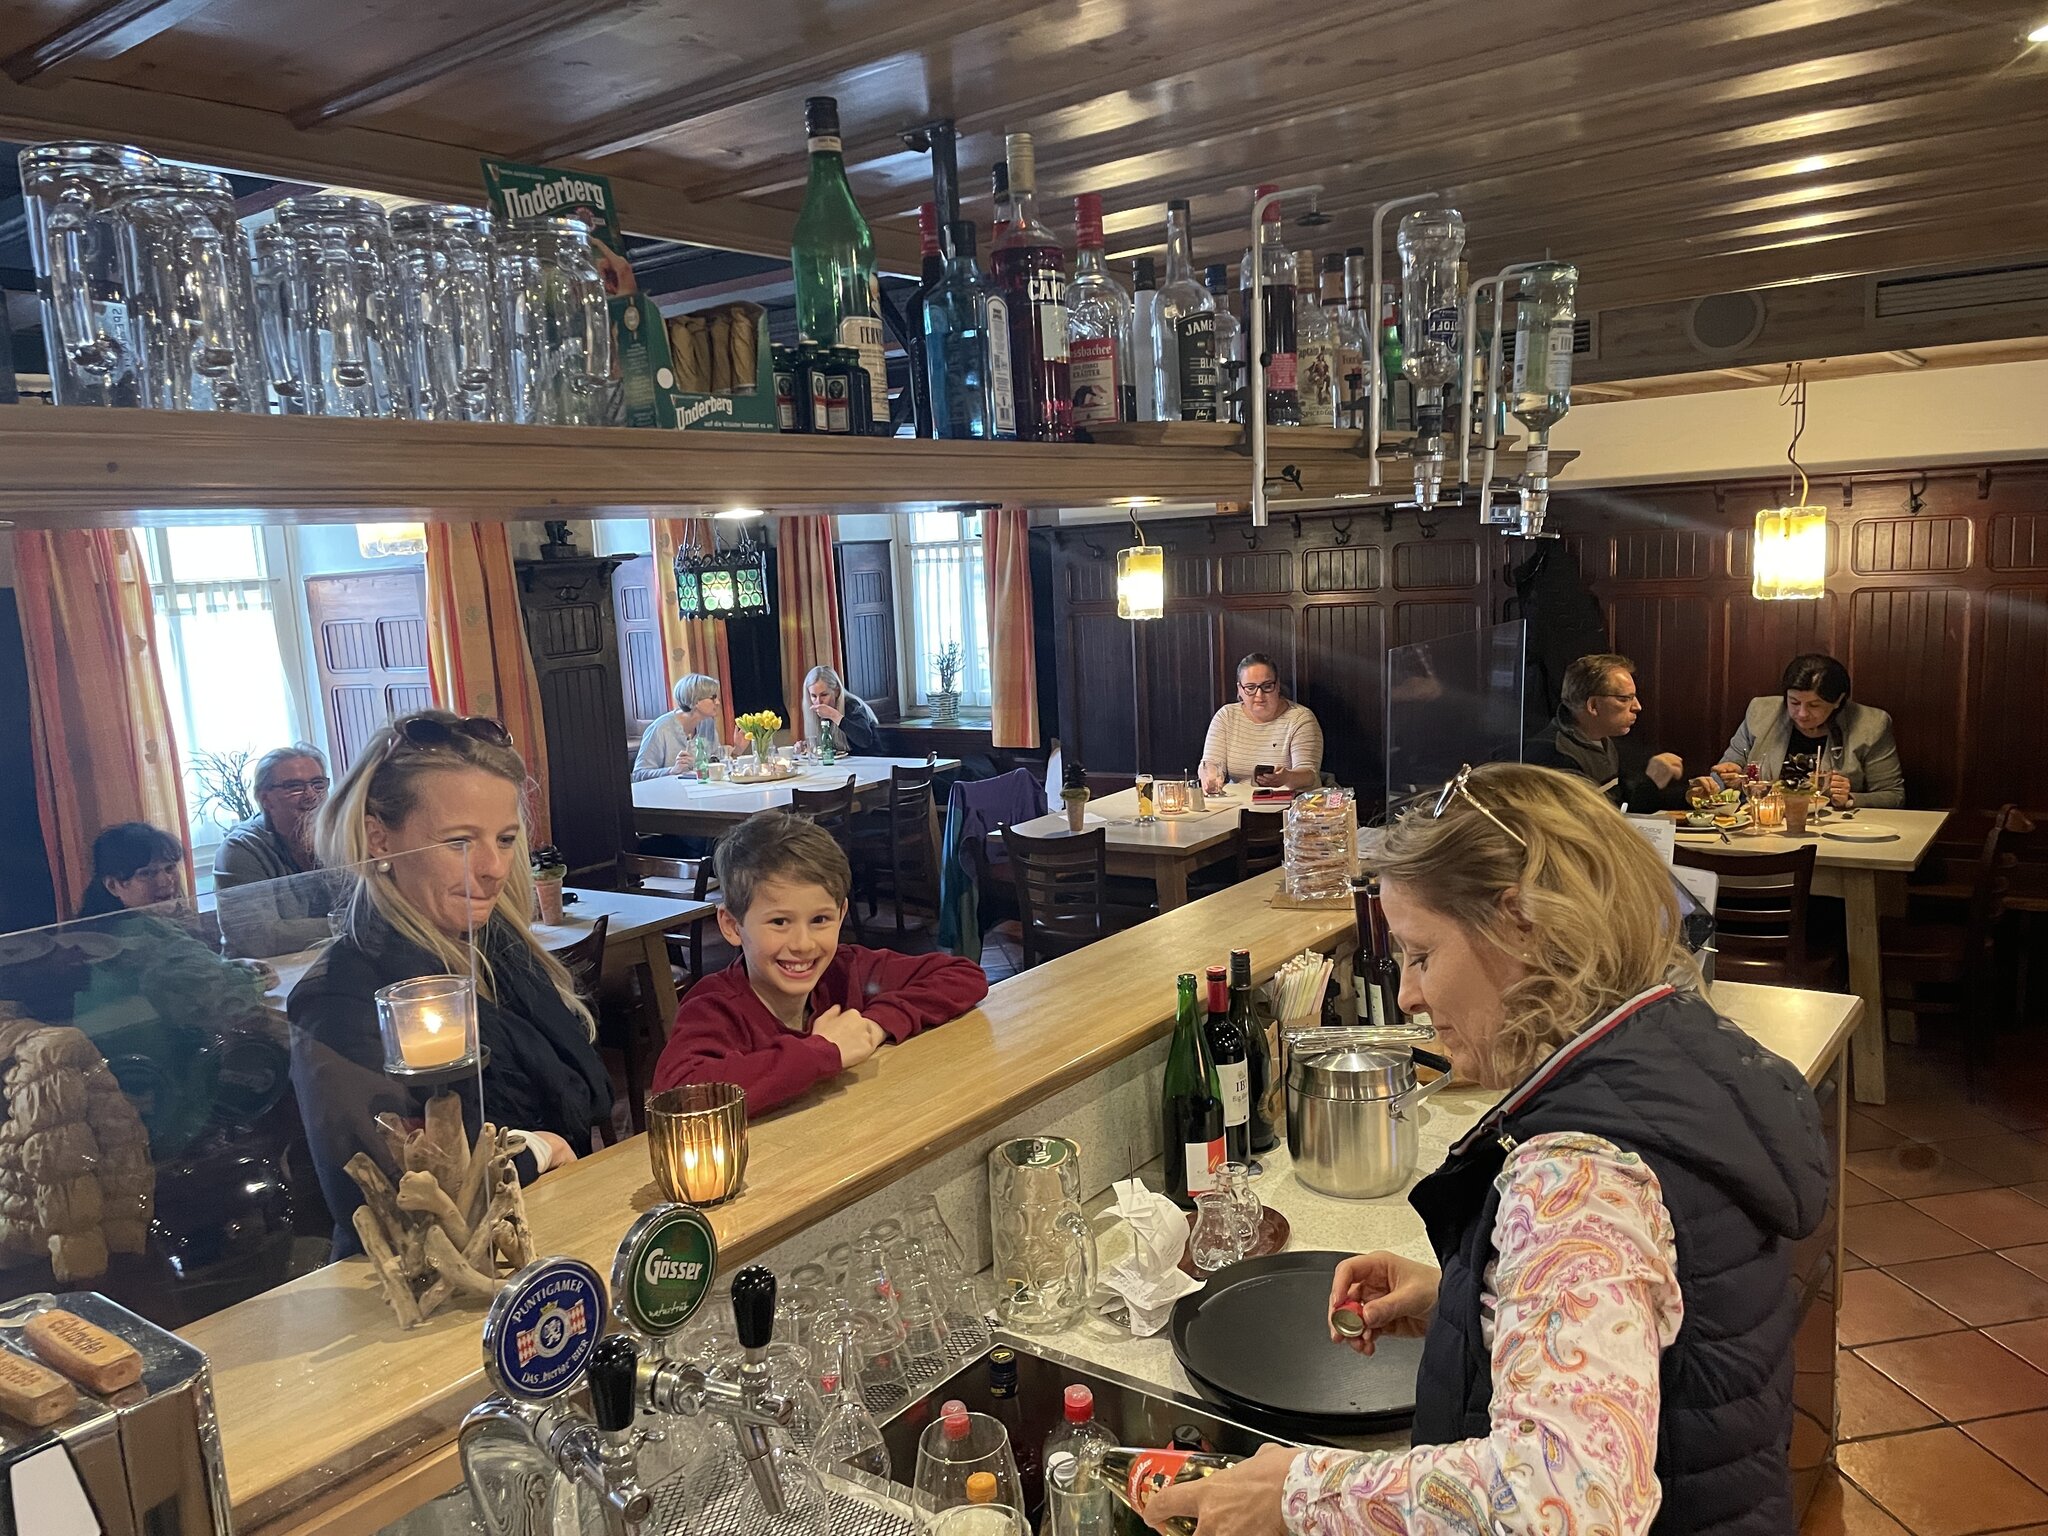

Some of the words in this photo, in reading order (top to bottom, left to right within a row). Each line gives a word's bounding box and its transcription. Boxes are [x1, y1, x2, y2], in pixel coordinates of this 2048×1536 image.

[501, 176, 606, 218] Underberg
[1027, 279, 1065, 300] CAMP
[859, 326, 882, 344] FERN
[1070, 343, 1112, 358] ssbacher
[675, 396, 733, 431] Underberg
[645, 1248, 703, 1285] Gösser
[511, 1279, 584, 1325] PUNTIGAMER
[521, 1371, 539, 1385] DAS
[571, 1339, 590, 1362] BIER
